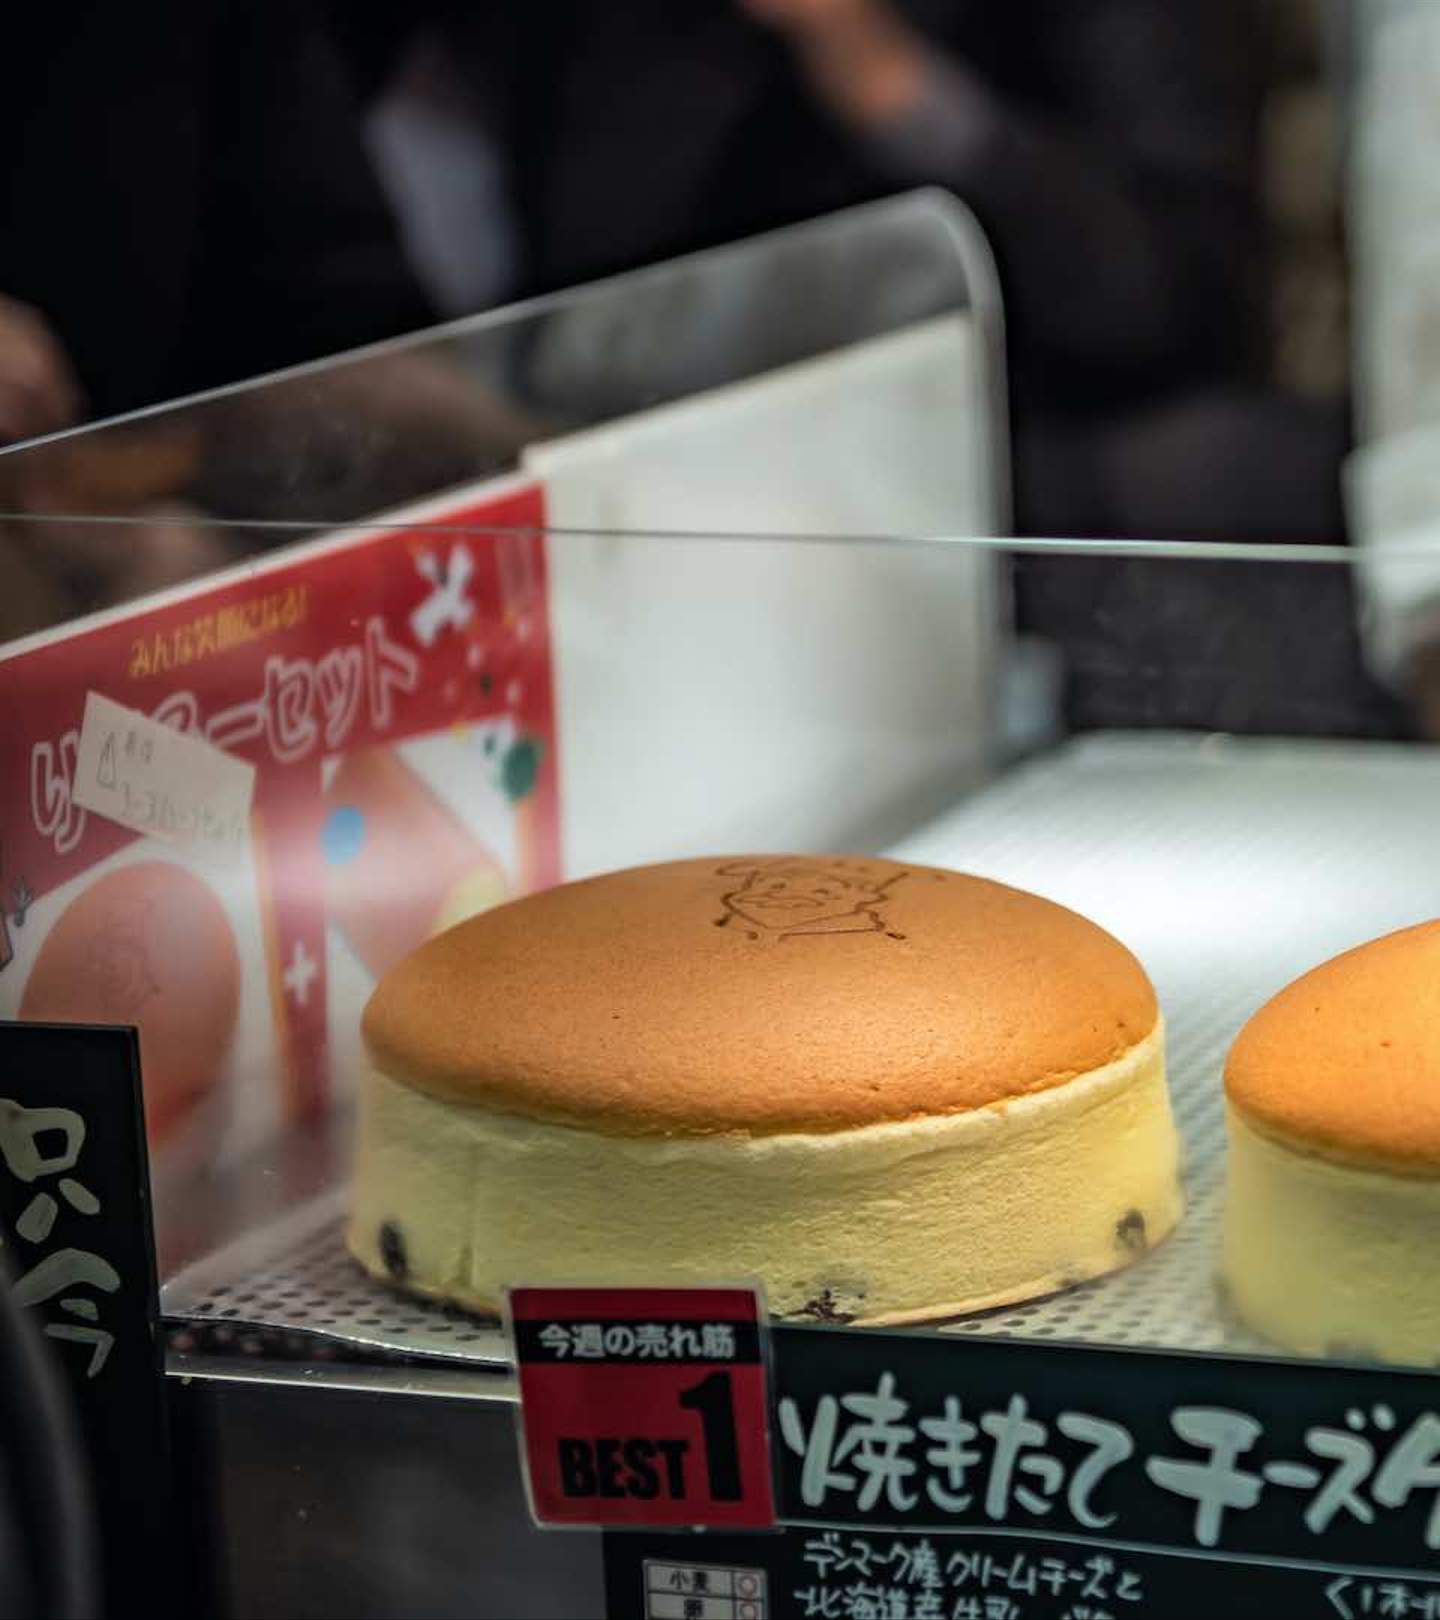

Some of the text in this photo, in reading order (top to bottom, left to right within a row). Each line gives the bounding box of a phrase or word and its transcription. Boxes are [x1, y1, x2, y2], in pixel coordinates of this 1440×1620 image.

[537, 1322, 737, 1362] 今週の売れ筋
[559, 1370, 744, 1503] BEST 1
